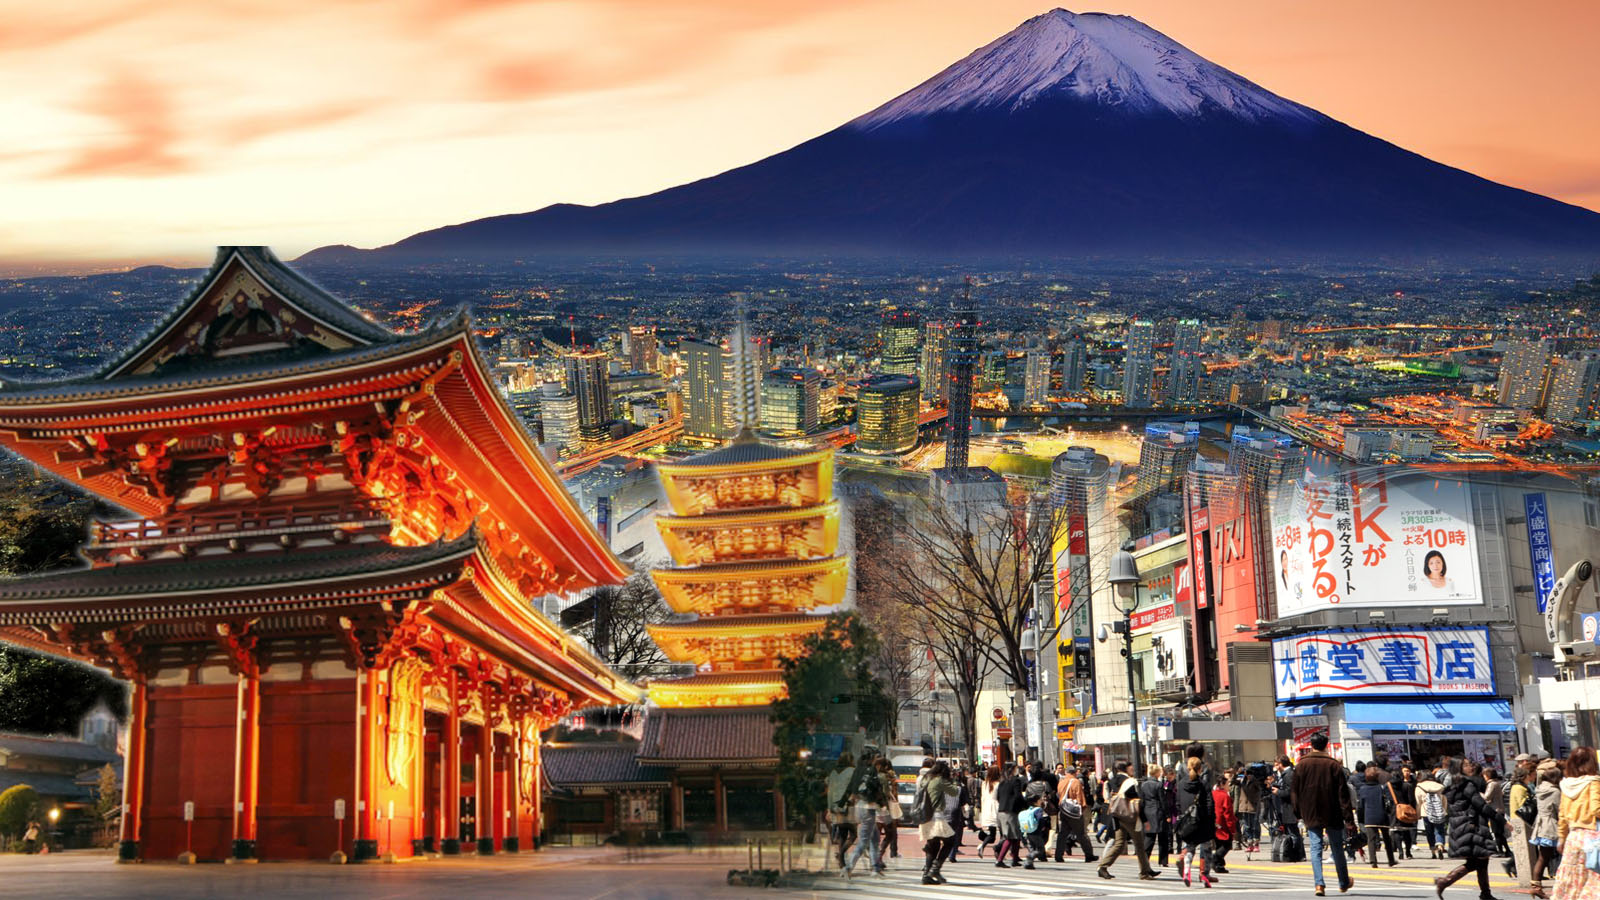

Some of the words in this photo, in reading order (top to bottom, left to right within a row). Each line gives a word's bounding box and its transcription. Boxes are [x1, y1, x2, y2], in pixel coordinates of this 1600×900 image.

[1403, 528, 1466, 549] よる10時
[1280, 640, 1476, 686] 大盛堂書店
